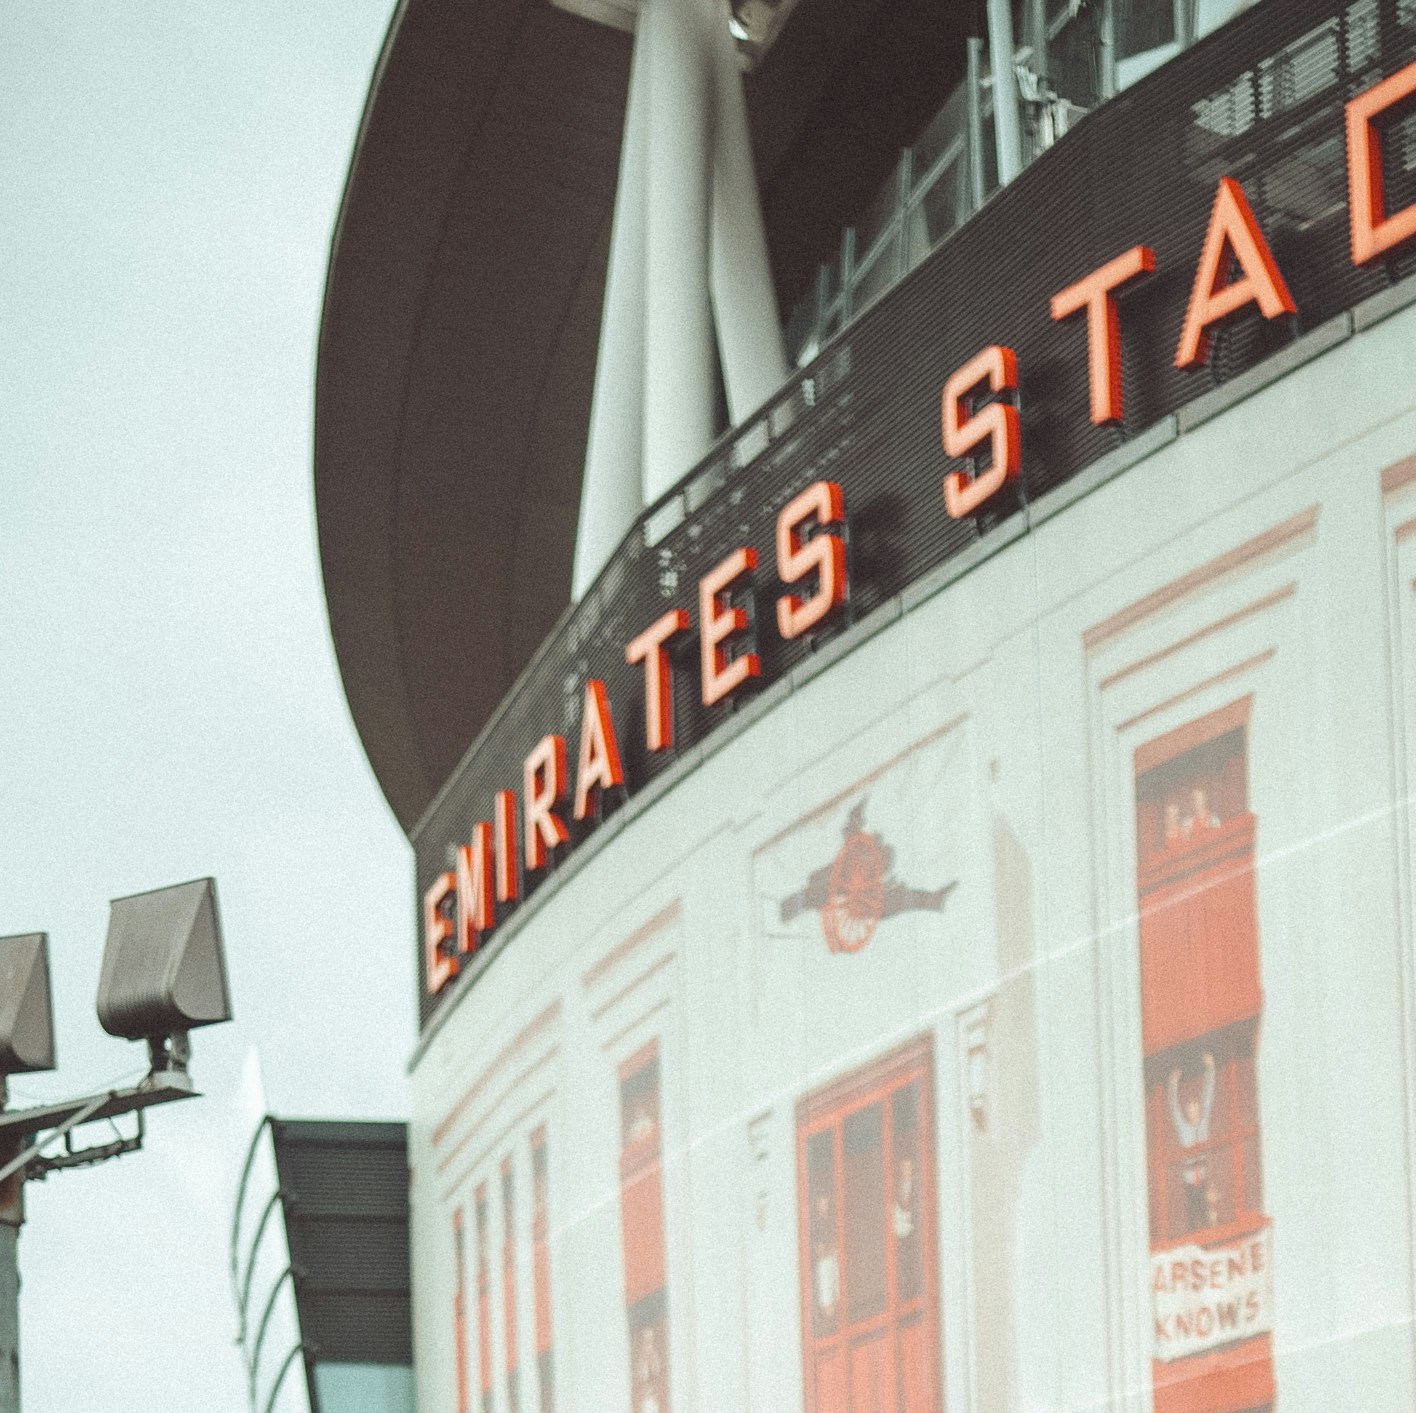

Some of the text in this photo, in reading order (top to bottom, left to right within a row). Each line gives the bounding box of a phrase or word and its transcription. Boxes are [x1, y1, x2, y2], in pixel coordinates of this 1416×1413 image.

[423, 480, 849, 997] EMIRATES
[1154, 1242, 1266, 1293] ARSENE
[1154, 1290, 1260, 1341] KNOWS
